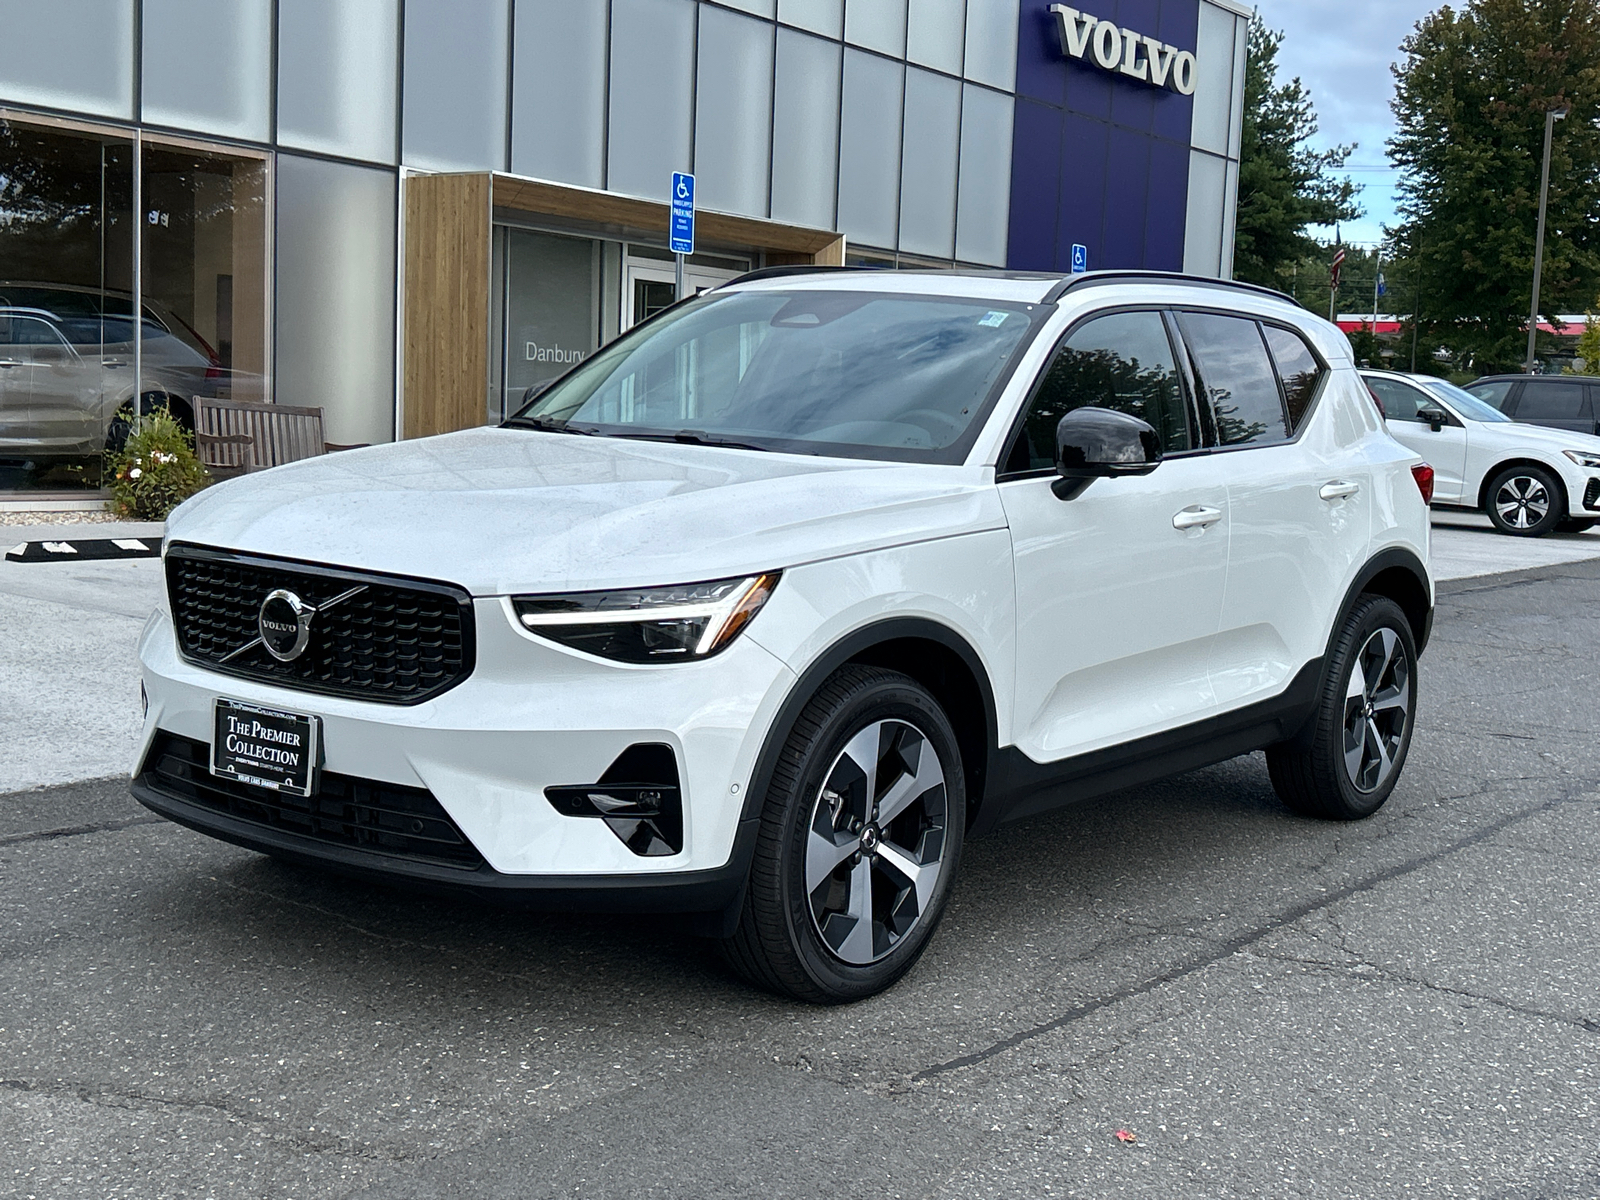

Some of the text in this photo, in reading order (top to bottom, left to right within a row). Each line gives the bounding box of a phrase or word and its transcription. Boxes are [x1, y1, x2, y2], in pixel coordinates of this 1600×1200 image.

[1051, 3, 1197, 95] VOLVO
[673, 207, 693, 219] PARKING
[262, 619, 297, 633] VOLVO
[227, 715, 301, 747] THE PREMIER
[226, 733, 299, 766] COLLECTION
